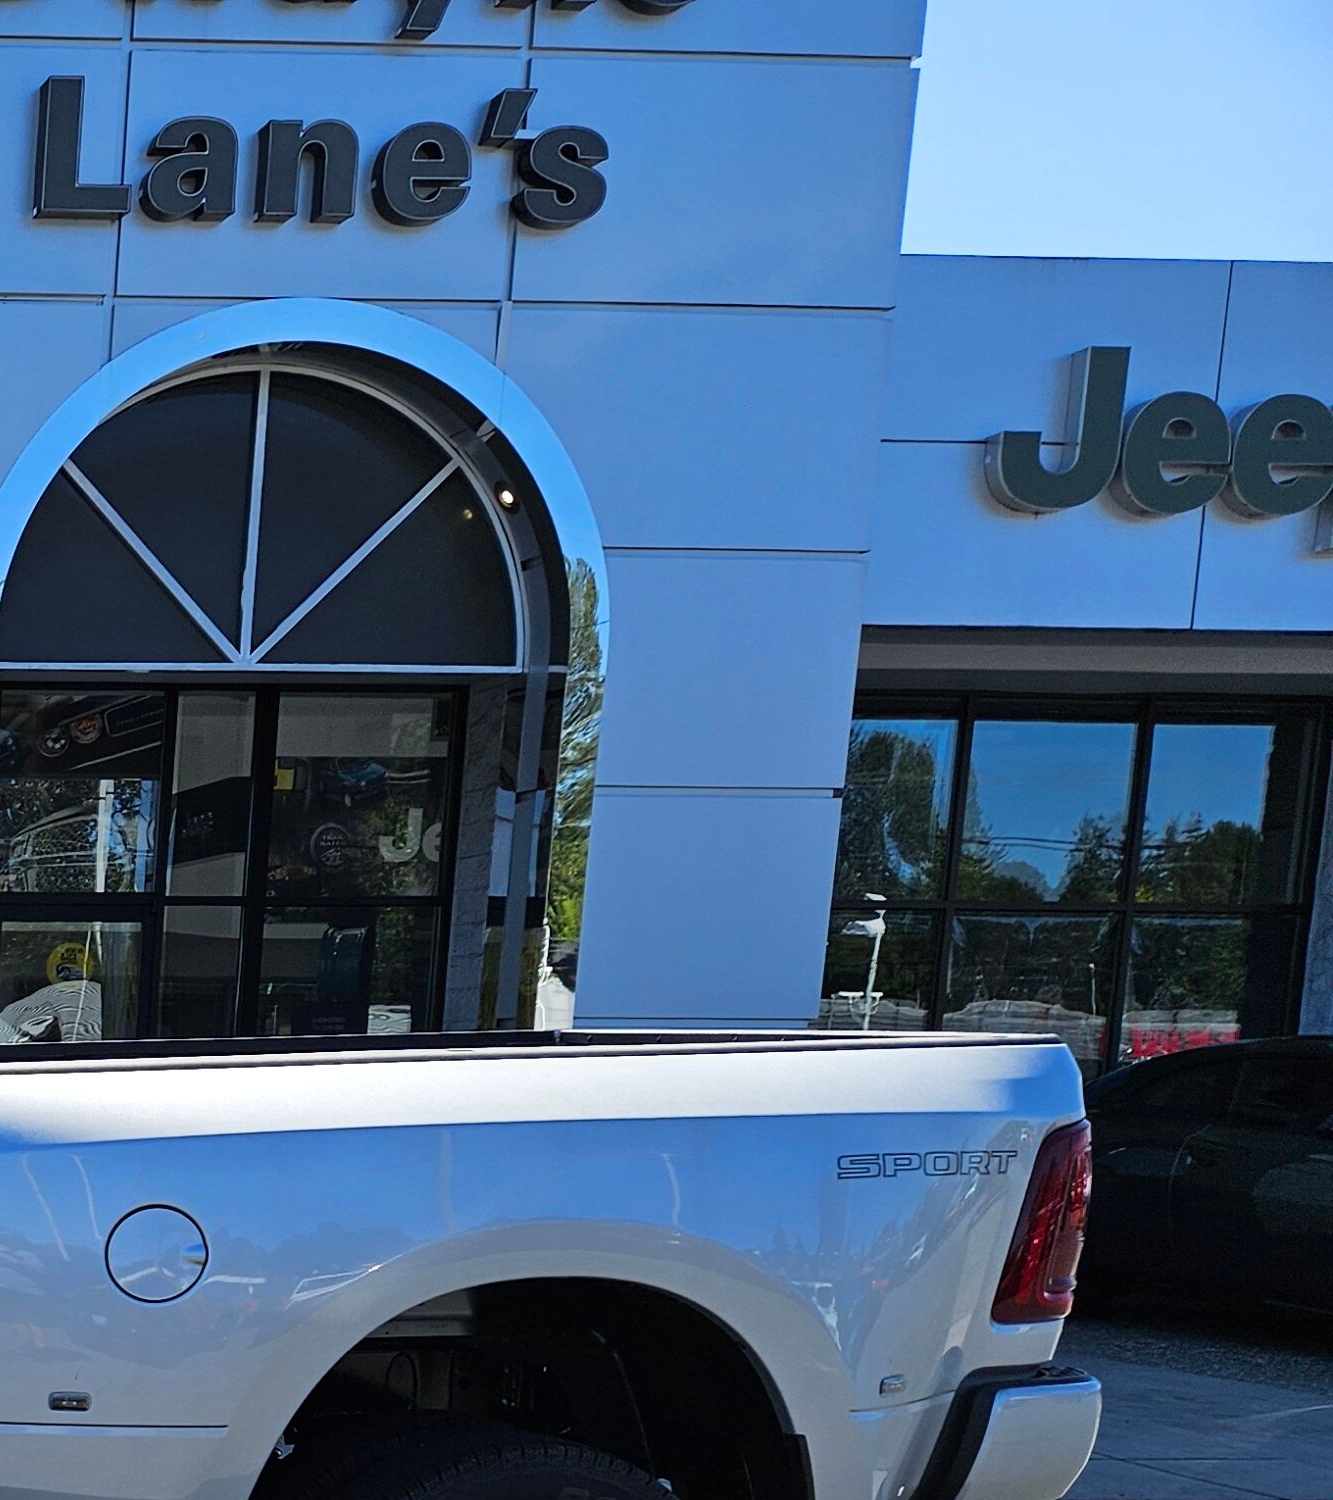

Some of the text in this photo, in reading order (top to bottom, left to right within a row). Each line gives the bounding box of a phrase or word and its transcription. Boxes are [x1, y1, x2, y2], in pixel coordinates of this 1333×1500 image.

[32, 75, 609, 230] Lane's
[984, 345, 1333, 557] Jee
[837, 1150, 1018, 1180] SPORT
